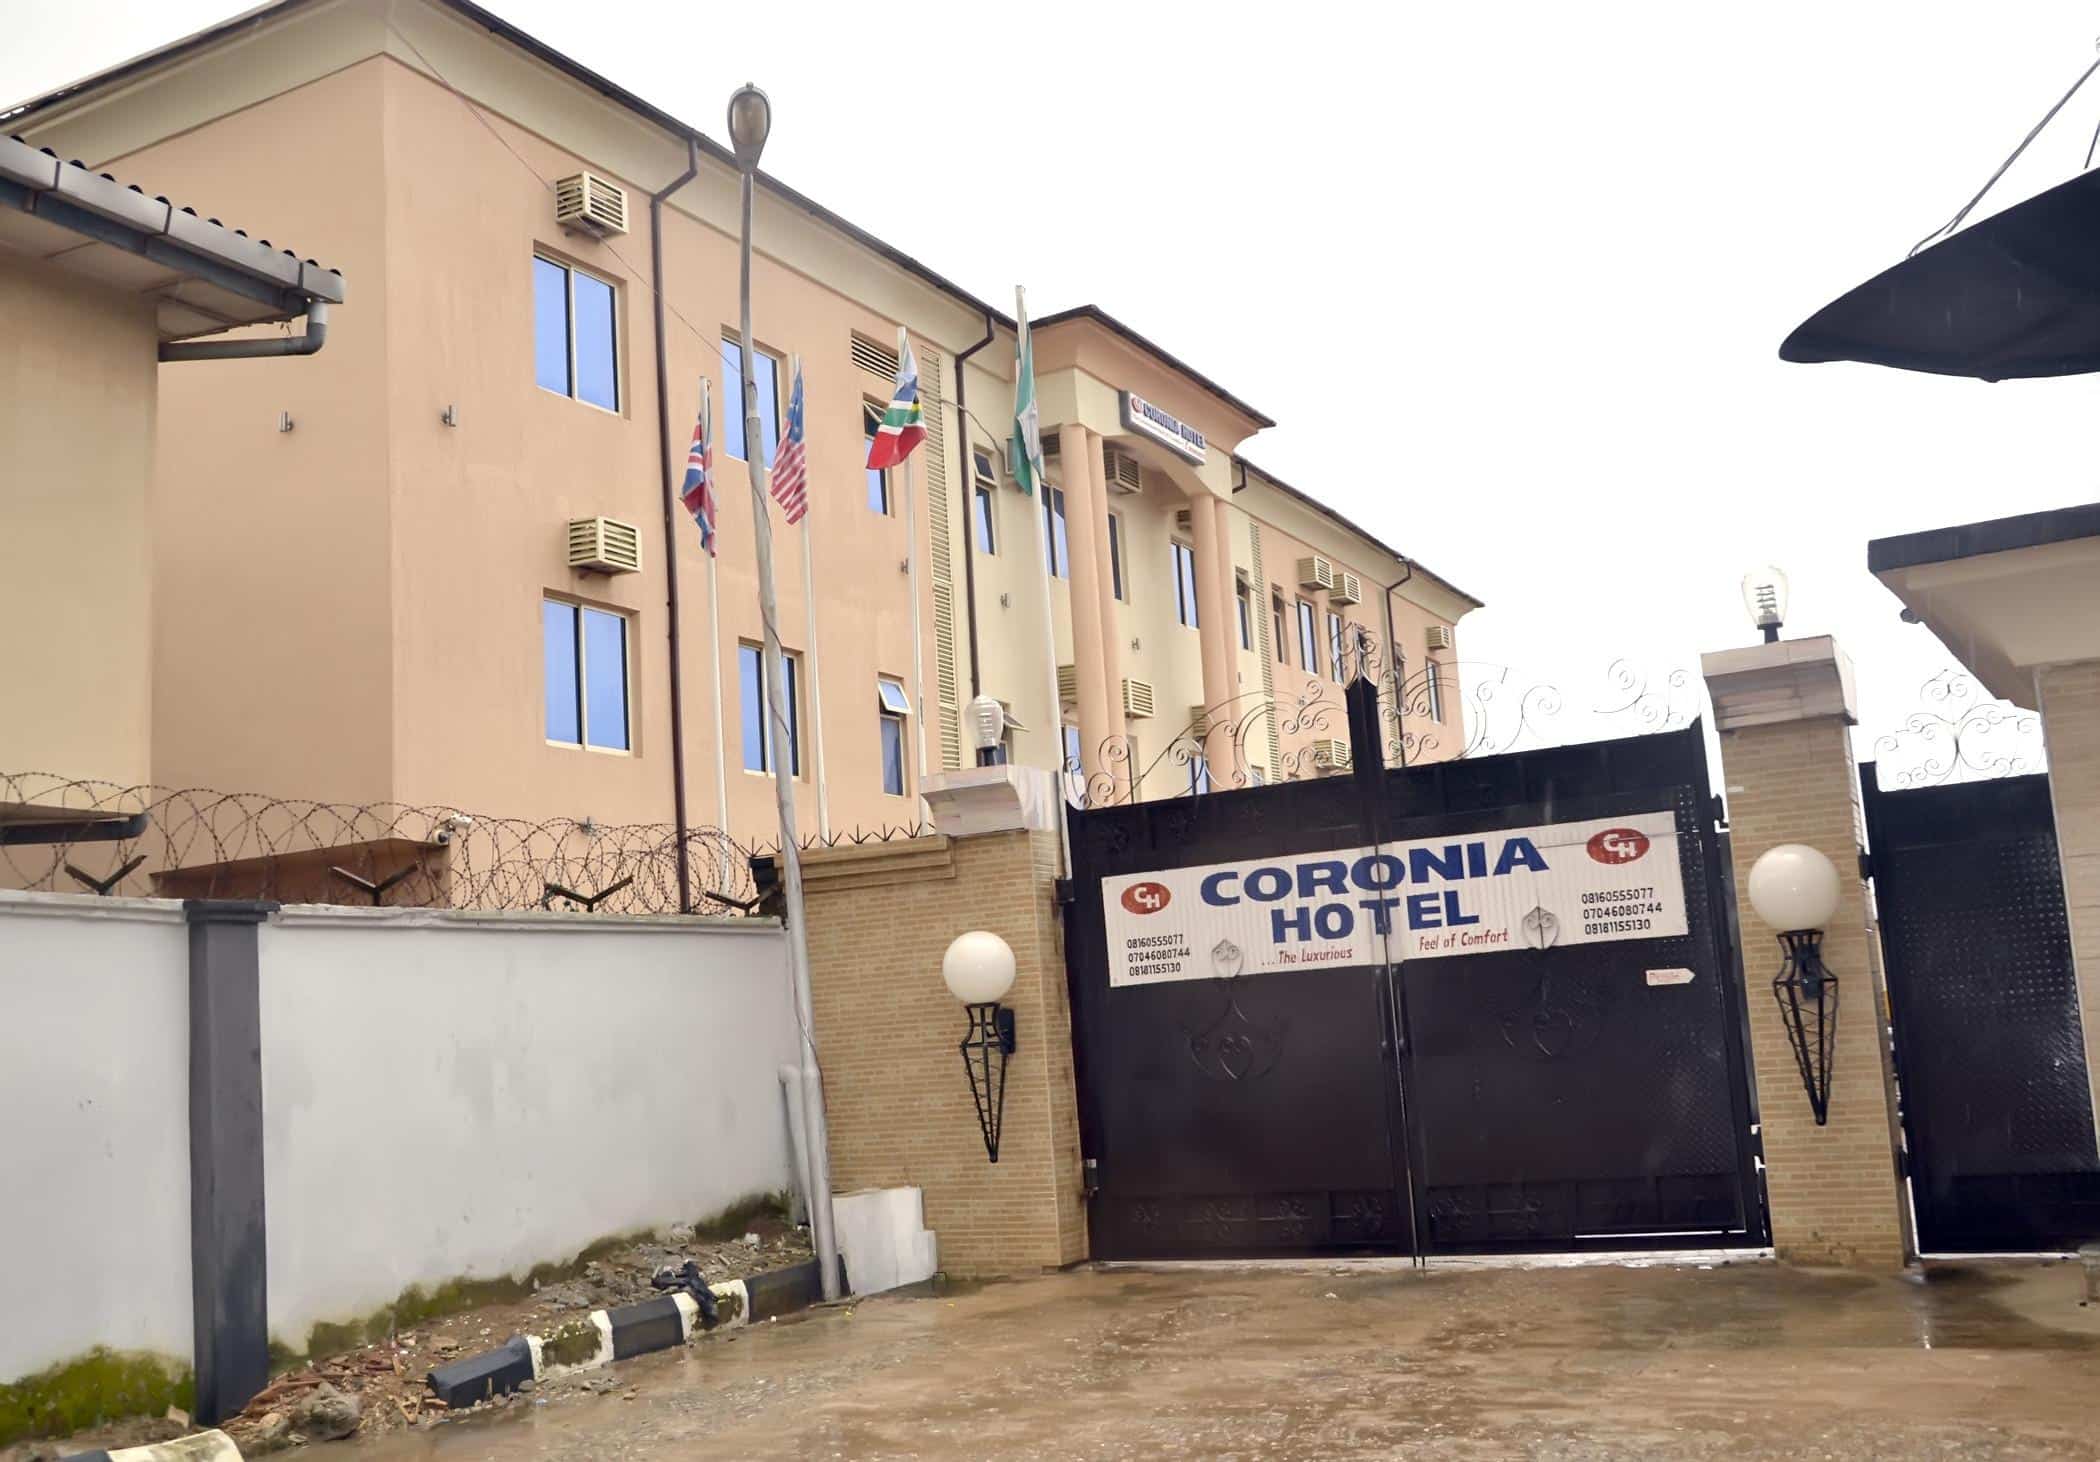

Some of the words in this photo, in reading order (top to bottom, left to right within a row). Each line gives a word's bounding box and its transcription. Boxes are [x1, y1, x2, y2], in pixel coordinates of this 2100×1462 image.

[1181, 423, 1205, 449] HOTEL
[1603, 833, 1637, 857] CH
[1200, 837, 1549, 906] CORONIA
[1134, 887, 1160, 908] CH
[1581, 888, 1653, 904] 08160555077
[1271, 890, 1480, 943] HOTEL
[1584, 902, 1662, 919] 07046080744
[1585, 919, 1651, 935] 08181155130
[1127, 934, 1183, 949] 08160555077
[1419, 935, 1439, 951] Feel
[1443, 932, 1457, 947] of
[1461, 928, 1509, 946] Comfort
[1128, 947, 1190, 962] 07046080744
[1301, 948, 1353, 963] Luxurious
[1129, 962, 1181, 976] 08181155130
